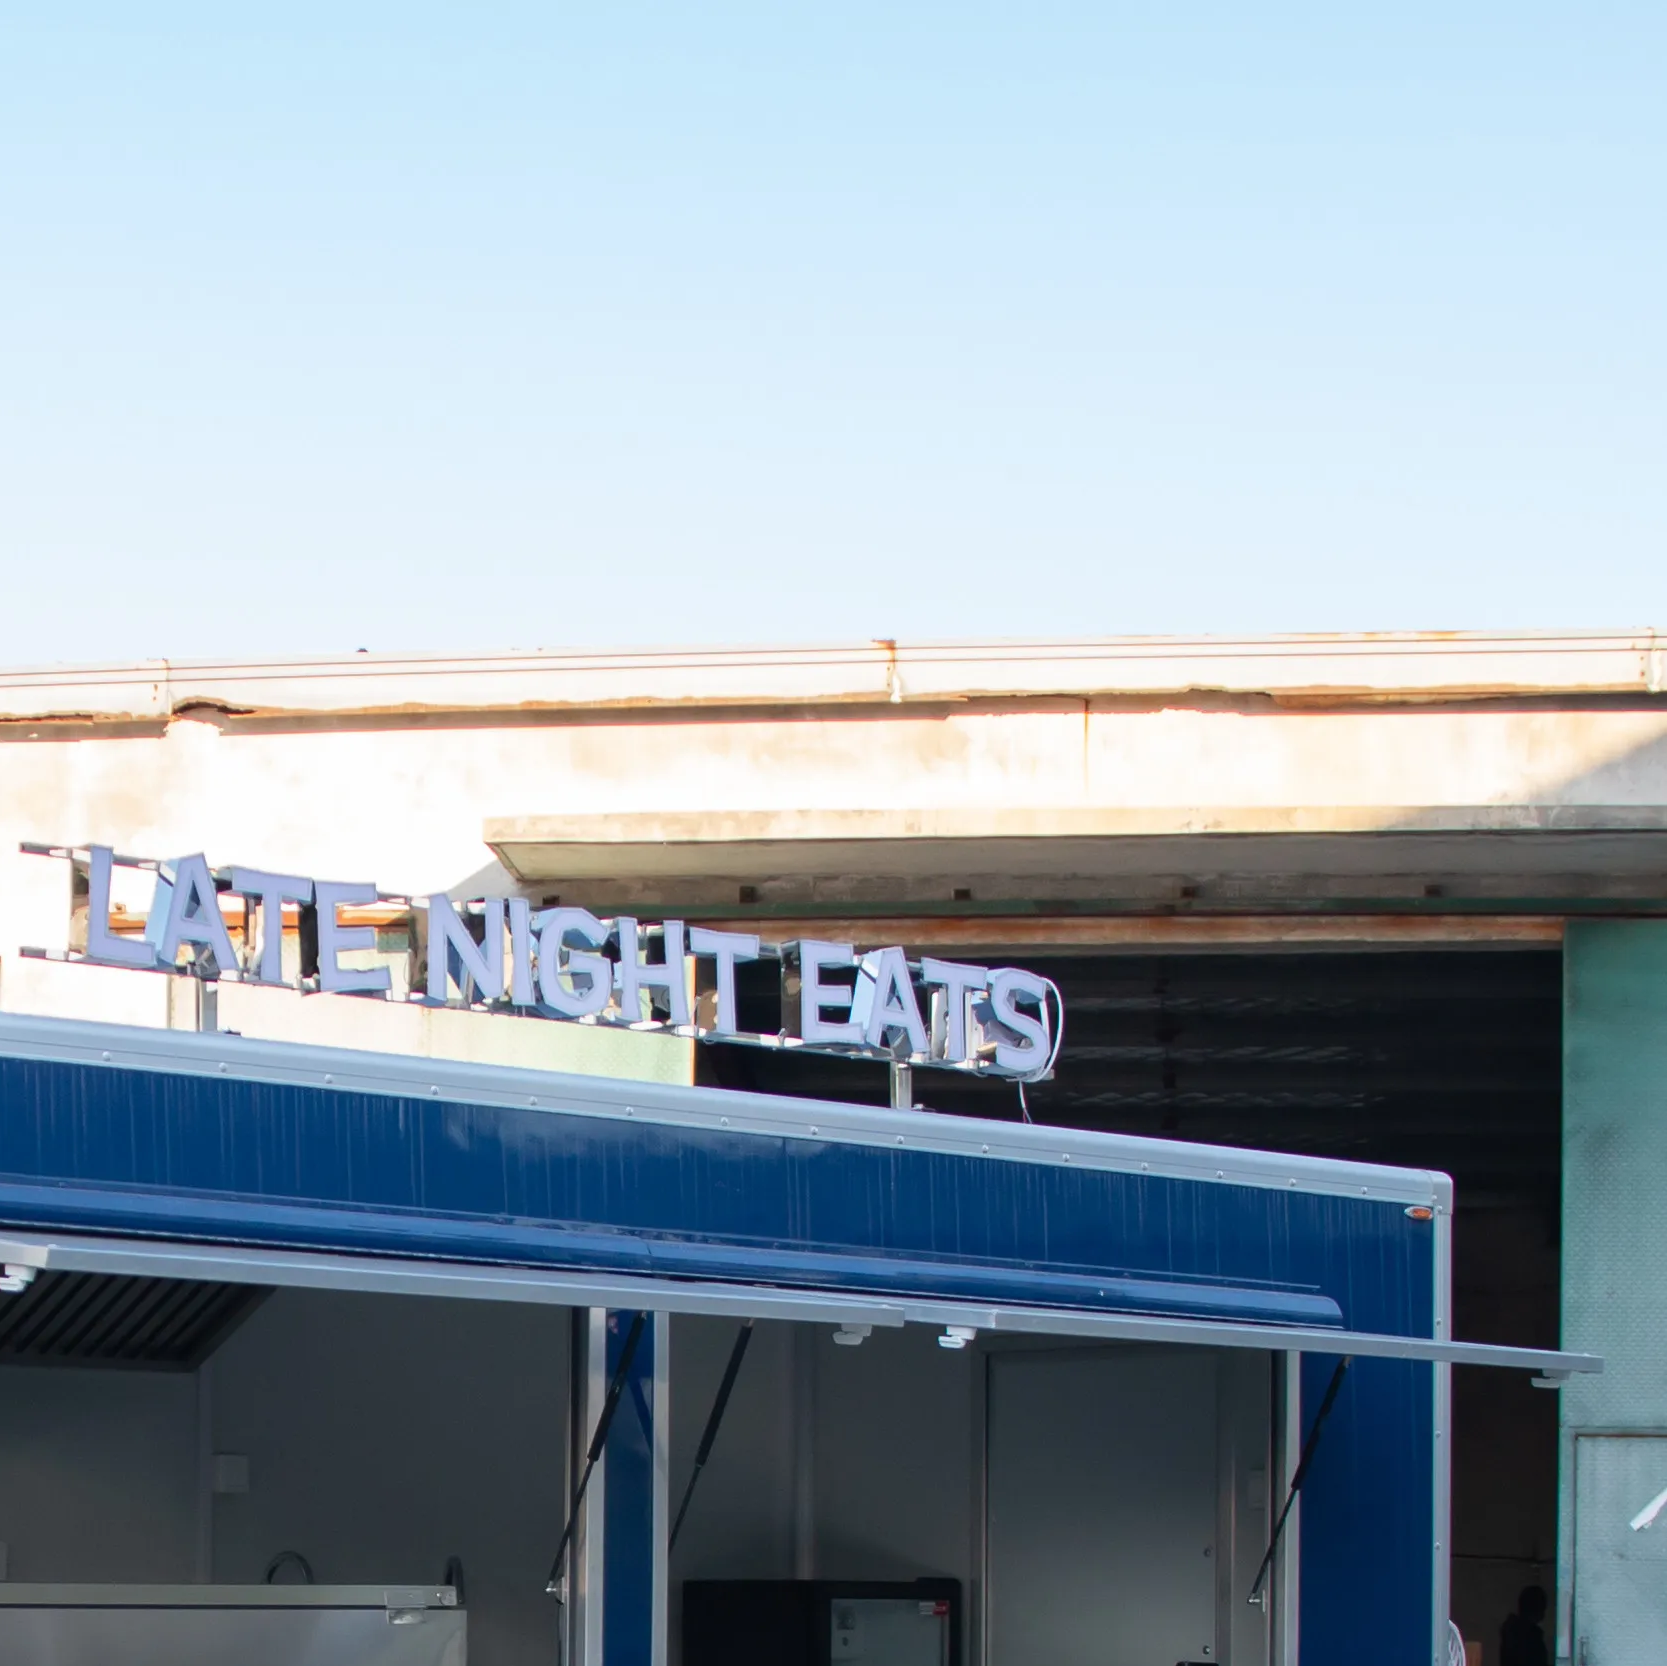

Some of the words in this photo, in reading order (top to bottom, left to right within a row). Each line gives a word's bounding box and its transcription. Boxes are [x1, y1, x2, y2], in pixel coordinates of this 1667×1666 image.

[86, 844, 391, 993] LATE
[425, 892, 759, 1036] NIGHT
[798, 939, 1051, 1072] EATS
